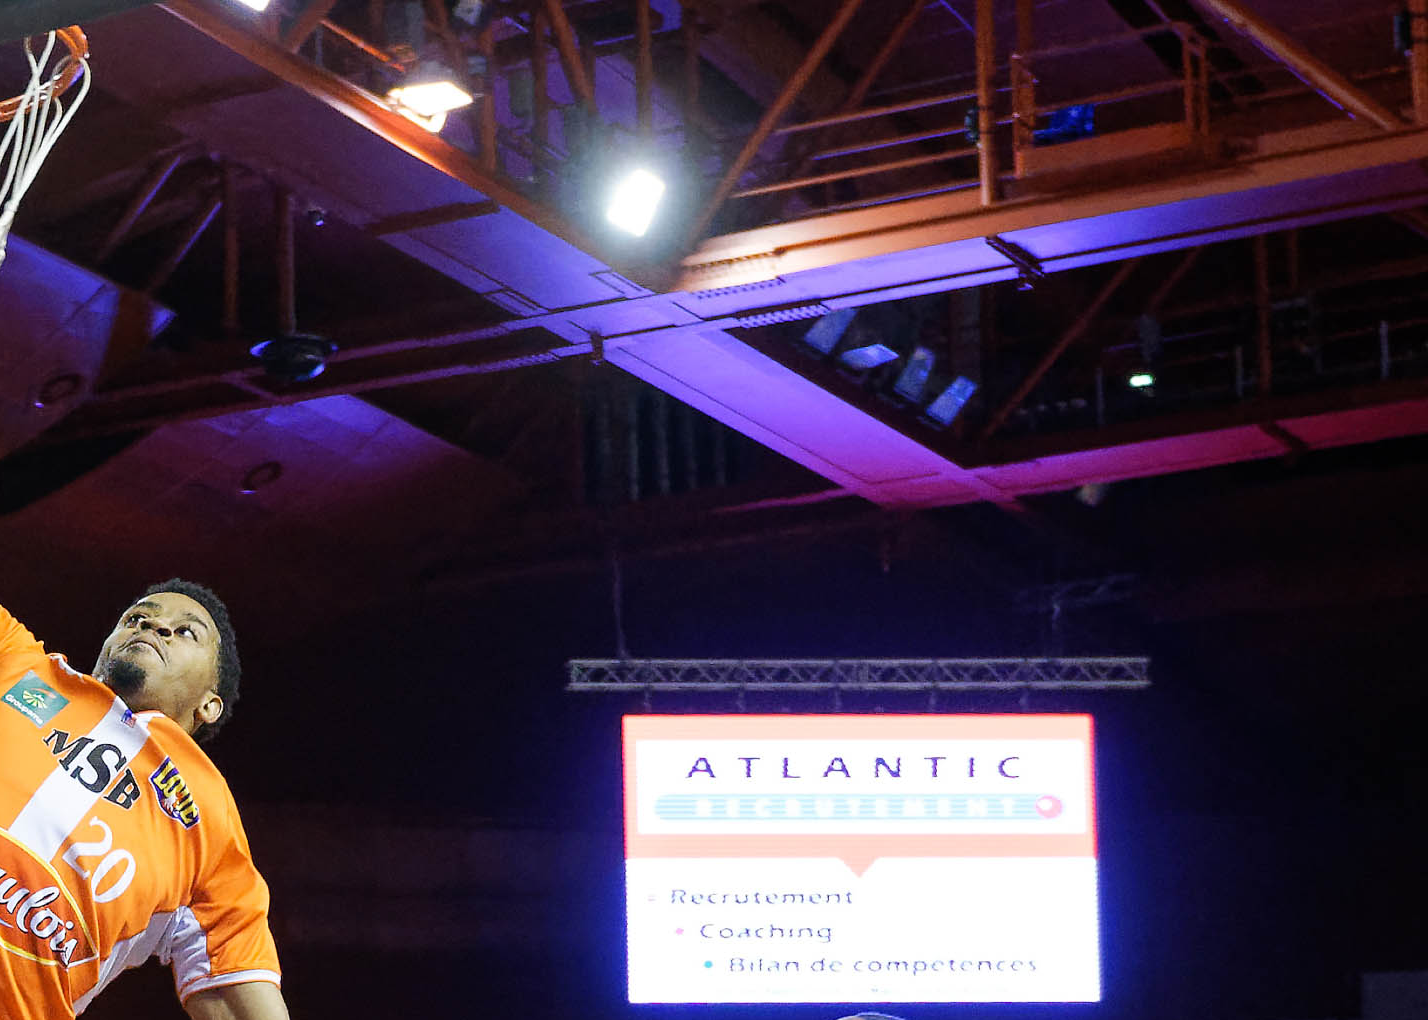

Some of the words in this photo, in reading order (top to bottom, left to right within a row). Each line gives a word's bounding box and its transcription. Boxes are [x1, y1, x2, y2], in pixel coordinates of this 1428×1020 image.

[42, 727, 142, 811] MSB
[685, 756, 1020, 779] ATLANTIC
[62, 815, 137, 904] 20
[670, 888, 853, 905] Recrutement
[699, 923, 832, 944] Coaching
[729, 957, 800, 973] Bilan
[809, 957, 844, 973] de
